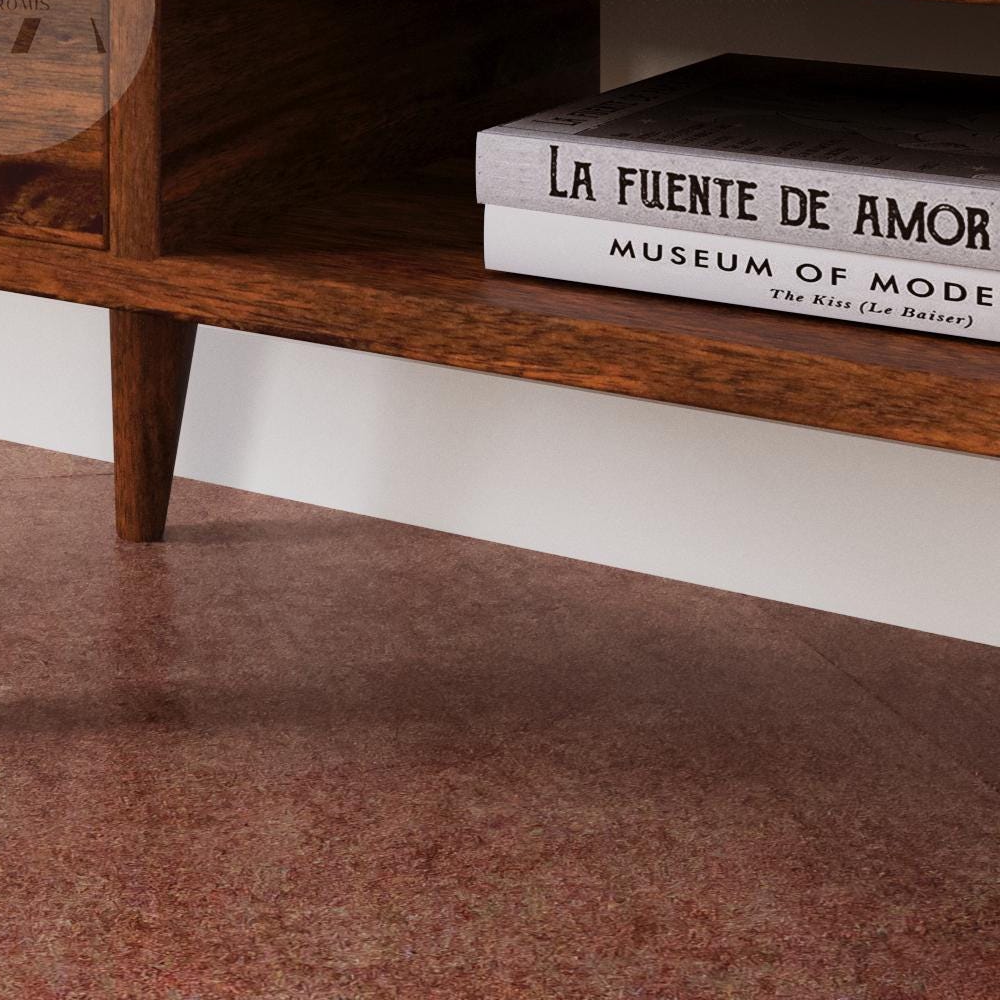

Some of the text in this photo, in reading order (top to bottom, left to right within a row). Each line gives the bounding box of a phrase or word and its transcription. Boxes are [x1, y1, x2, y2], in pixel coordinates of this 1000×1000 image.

[548, 144, 992, 251] LA FUENTE DE AMOR
[609, 238, 994, 307] MUSEUM OF MODE
[770, 288, 973, 328] The Kiss (Le Baiser)
